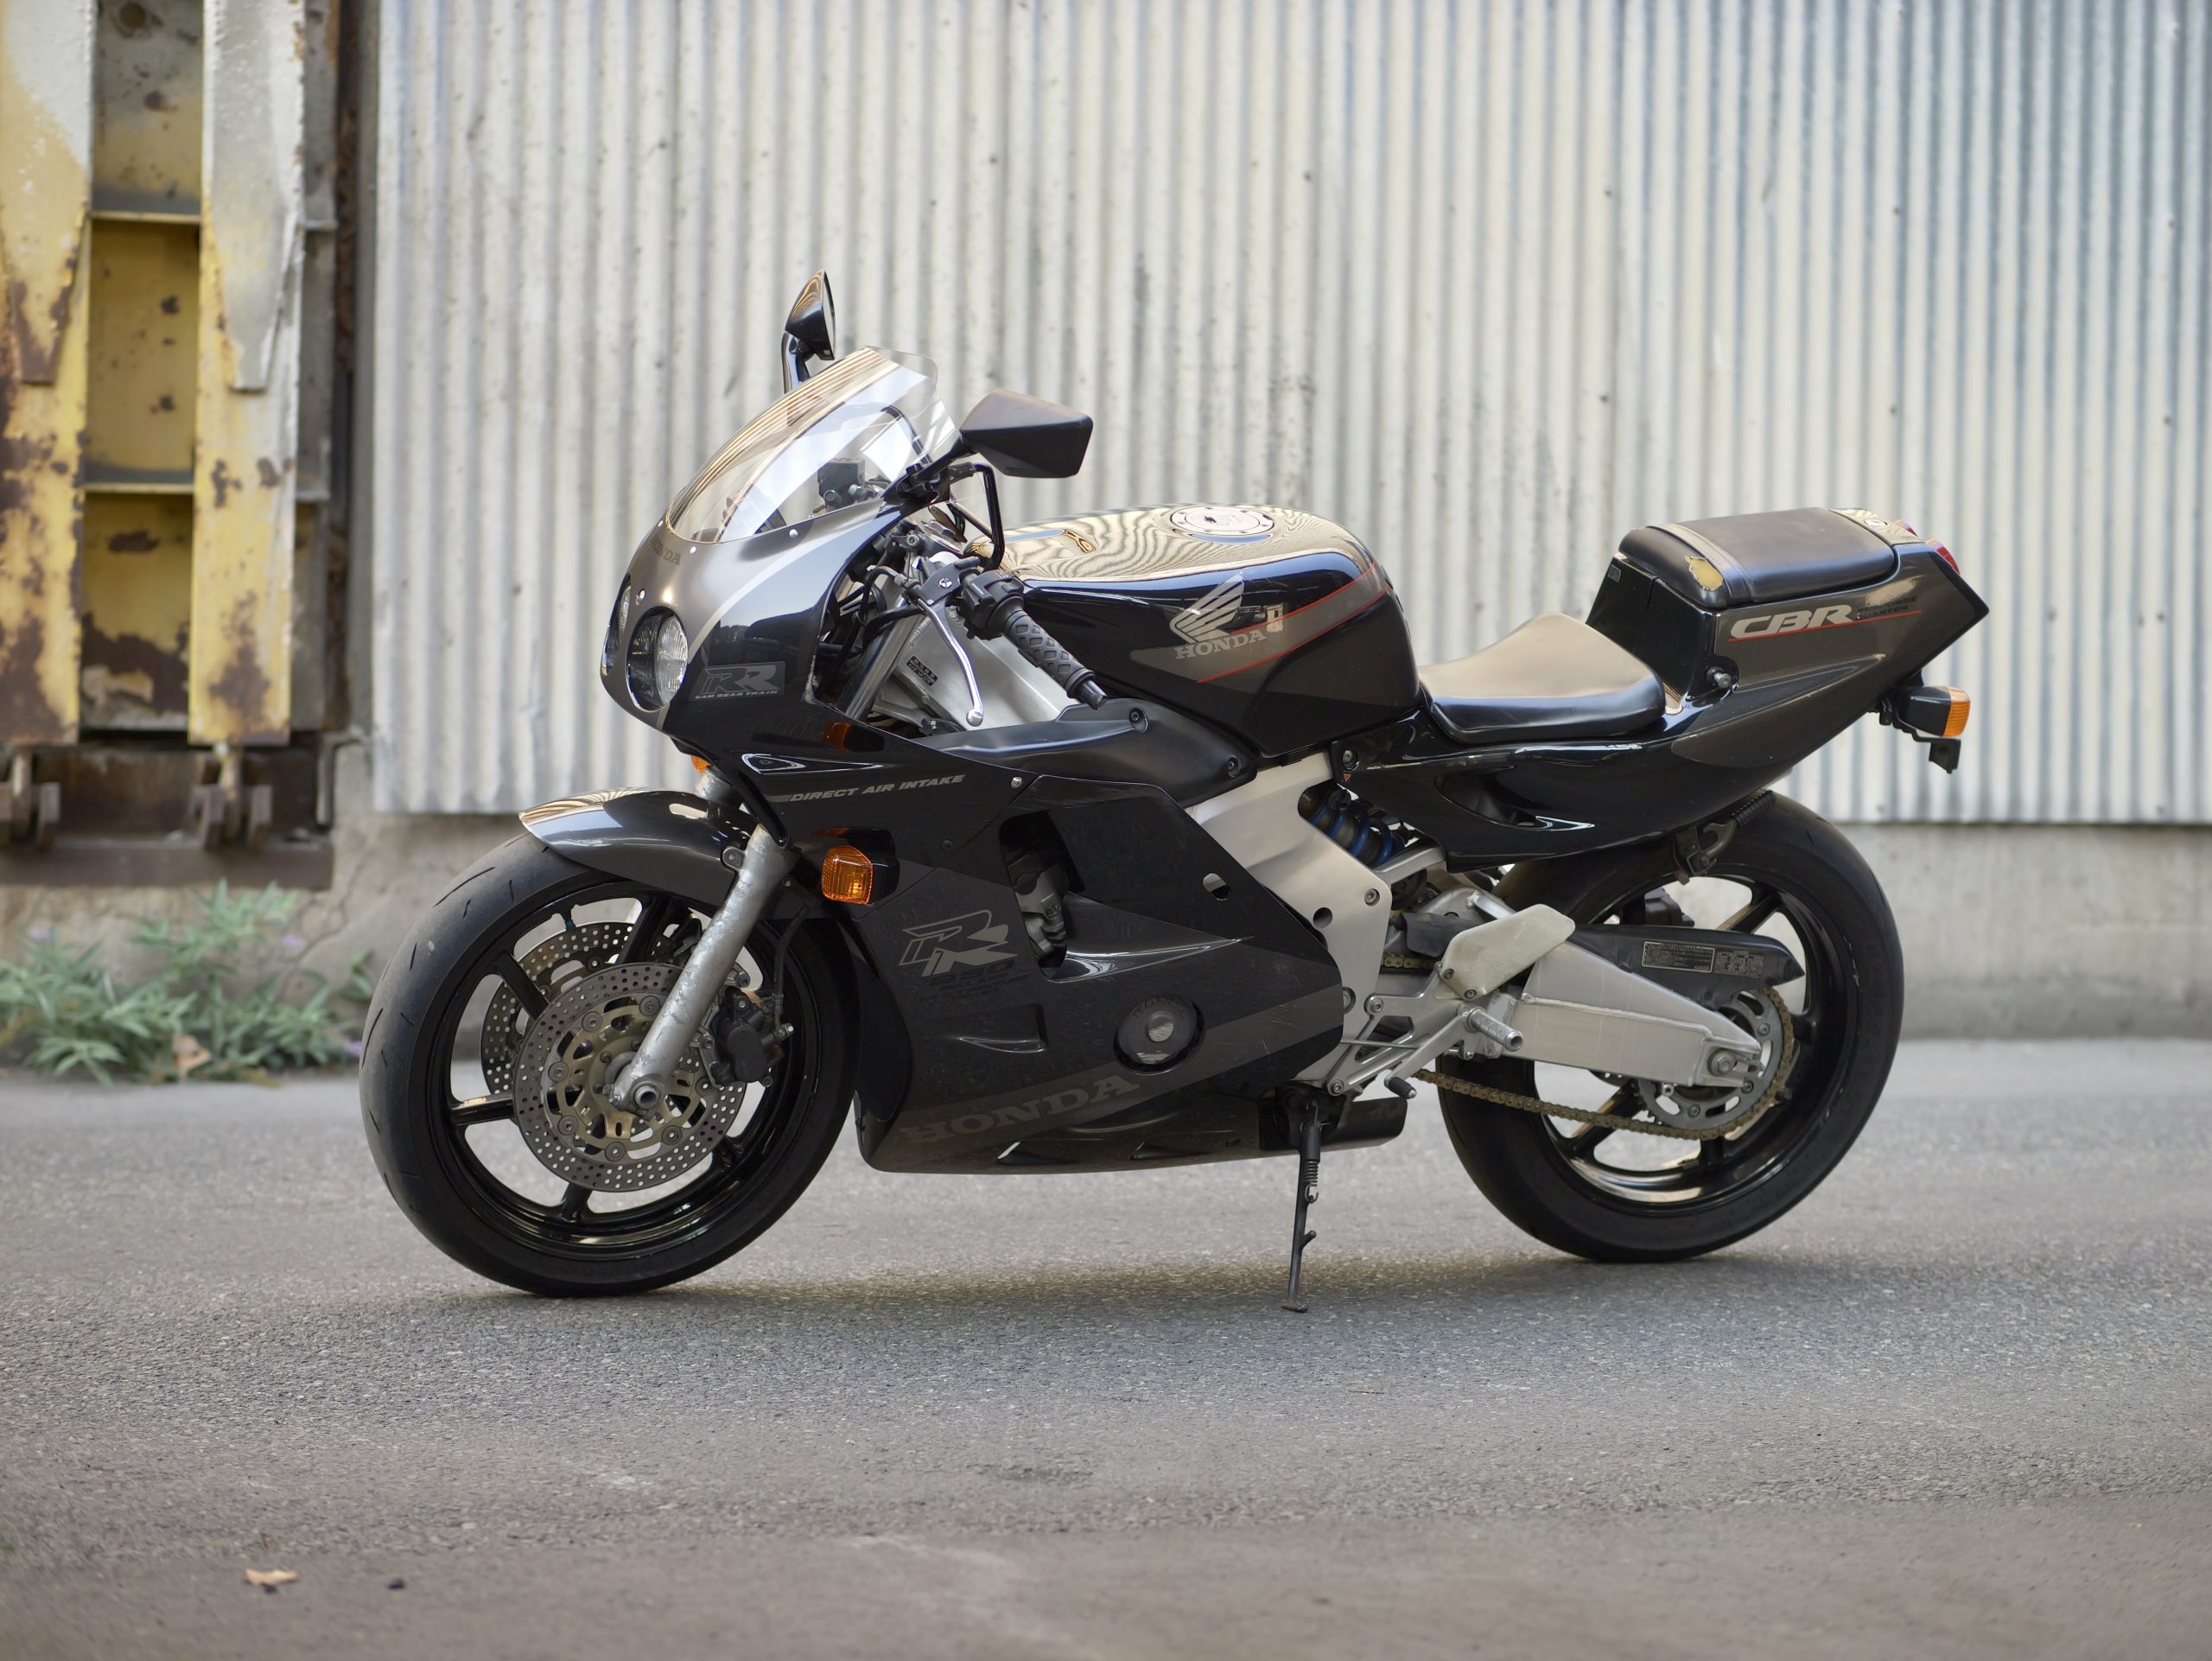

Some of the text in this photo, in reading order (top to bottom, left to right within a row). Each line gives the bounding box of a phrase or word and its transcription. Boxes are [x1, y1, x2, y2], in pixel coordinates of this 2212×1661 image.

[1730, 604, 1854, 639] CBR
[1173, 629, 1268, 660] HONDA
[790, 773, 966, 802] DIRECT AIR INTAKE
[899, 1075, 1140, 1144] HONDA
